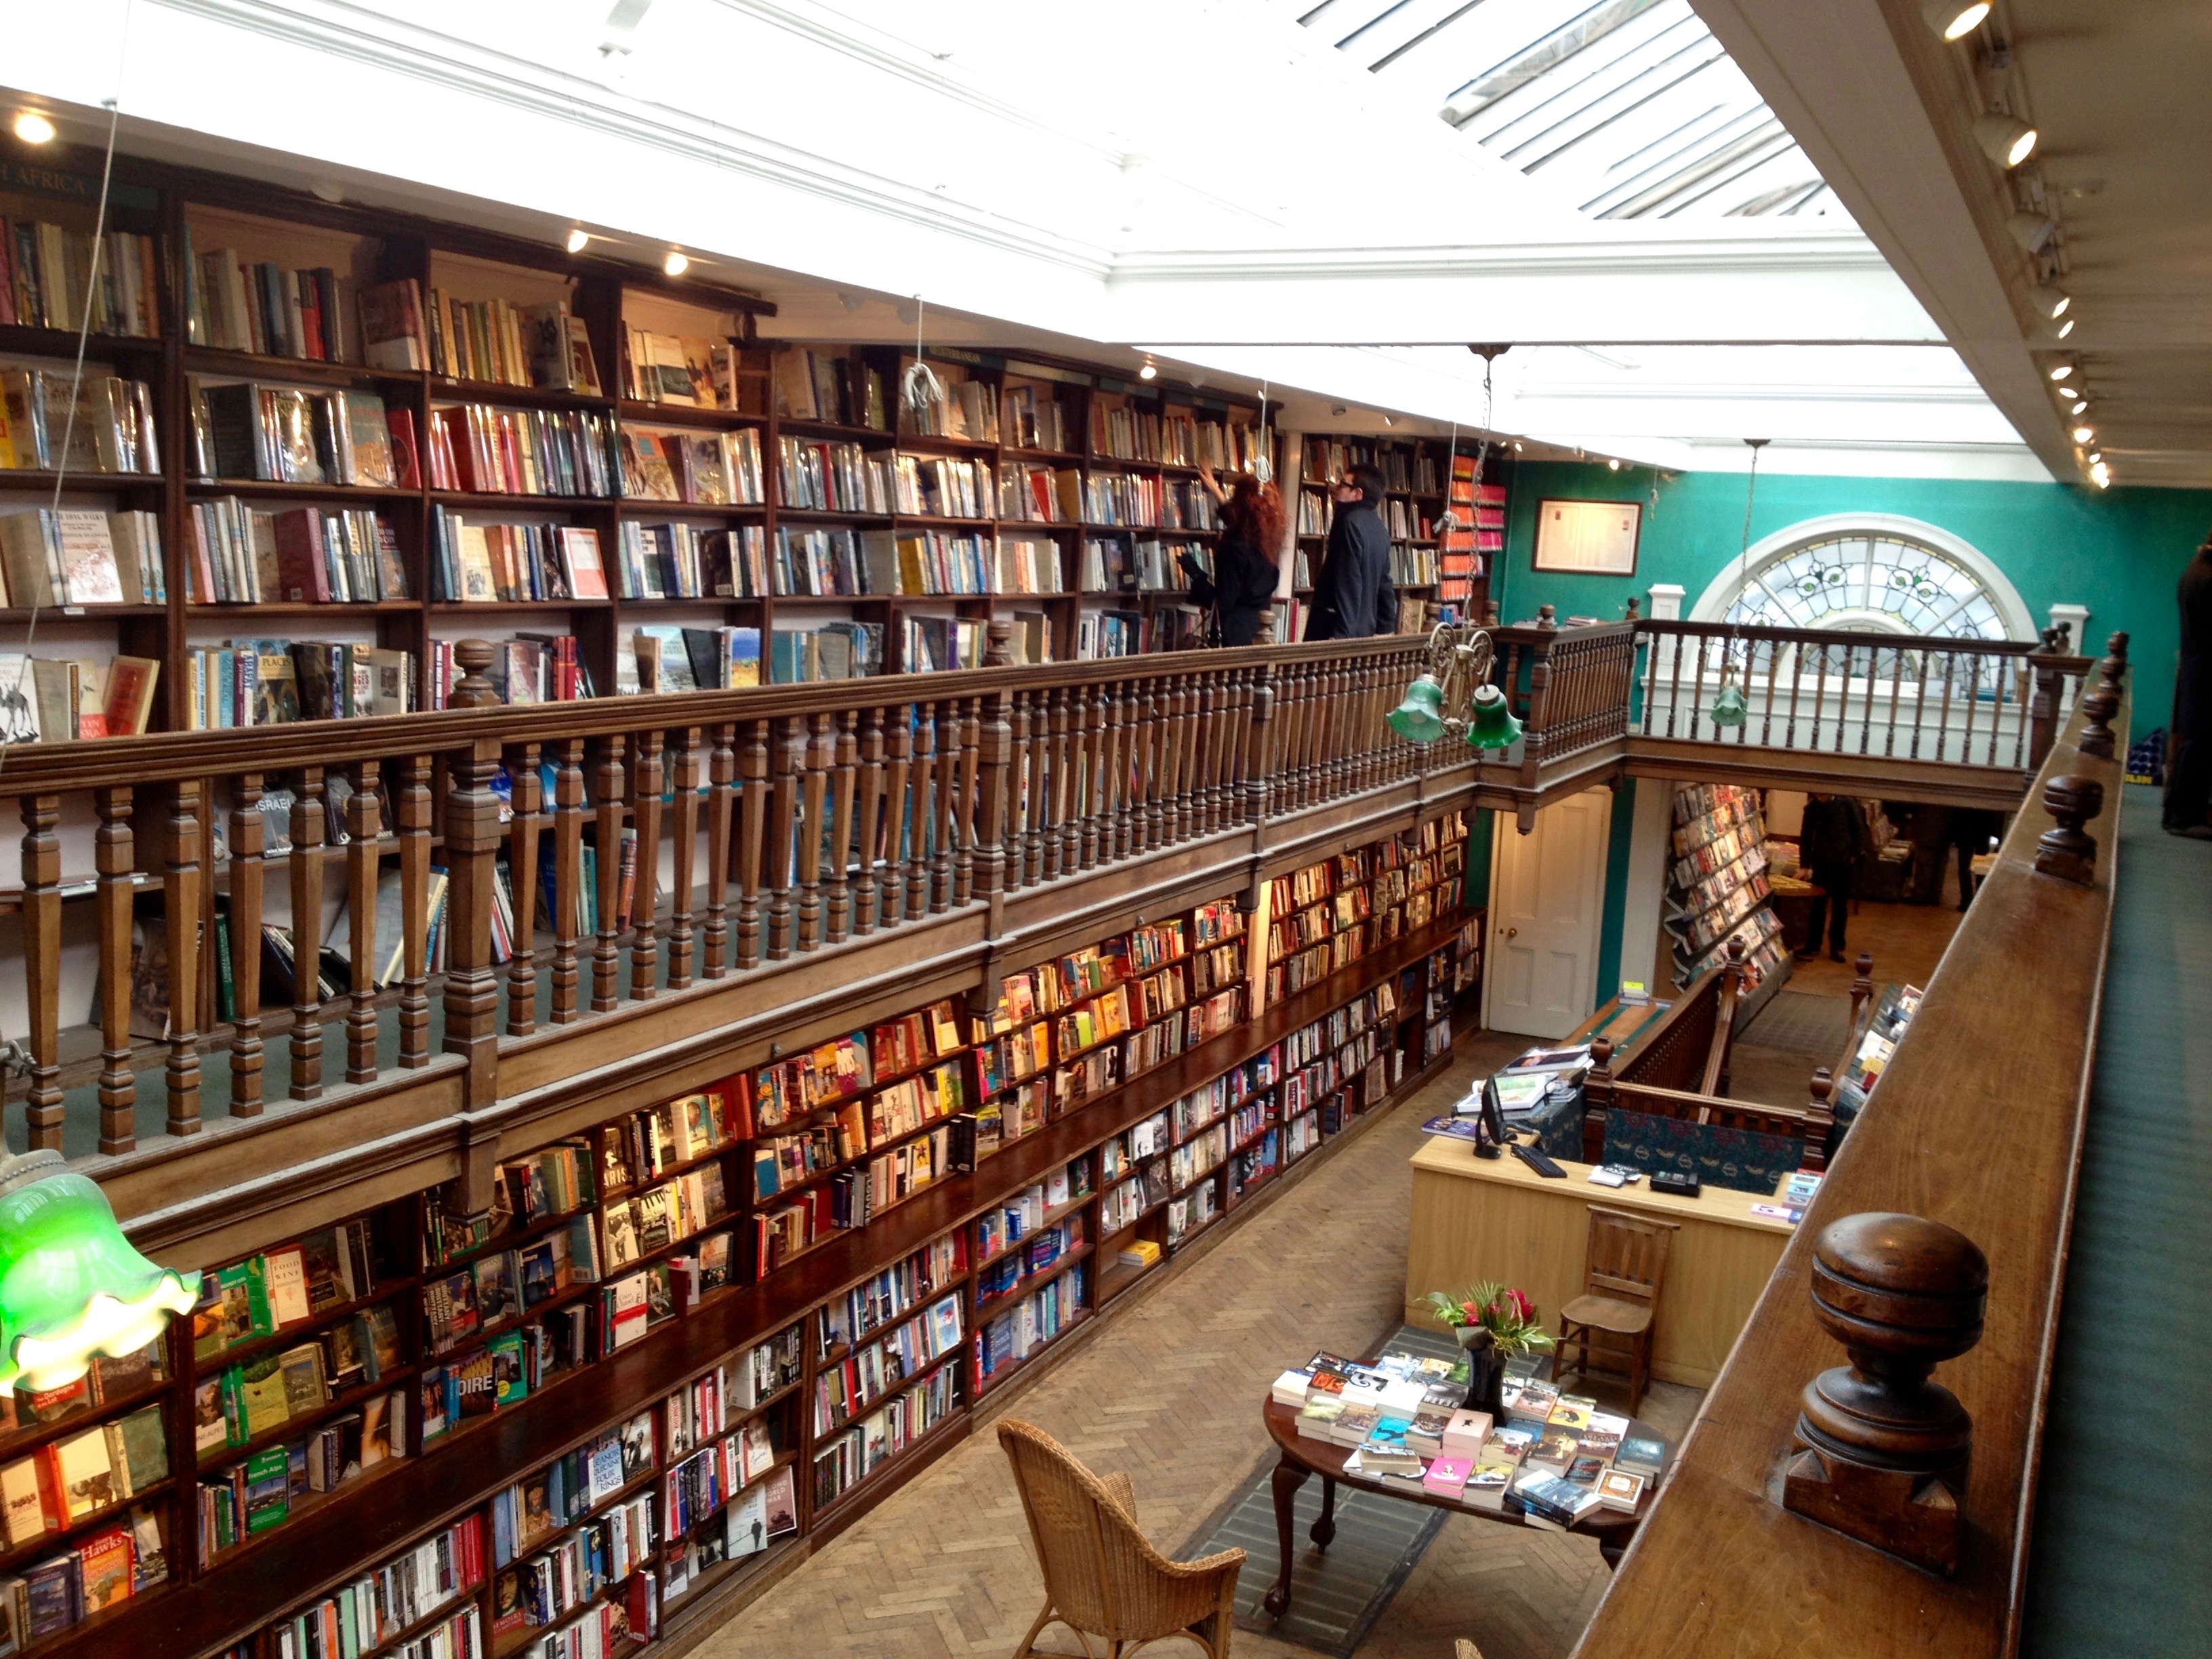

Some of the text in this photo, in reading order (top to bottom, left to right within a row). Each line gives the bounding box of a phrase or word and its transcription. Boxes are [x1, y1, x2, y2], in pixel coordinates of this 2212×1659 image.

[262, 657, 291, 667] PLACES
[243, 654, 254, 689] ARAFAT
[255, 798, 291, 812] SRAEL
[603, 1168, 628, 1187] ARIS
[273, 1260, 300, 1272] FOOD
[274, 1270, 300, 1280] WINE
[459, 1374, 493, 1396] OIRE
[196, 1427, 224, 1441] NE-ALPES
[600, 1475, 621, 1492] KINGS
[767, 1488, 785, 1497] ORLD
[81, 1536, 123, 1561] Hawks
